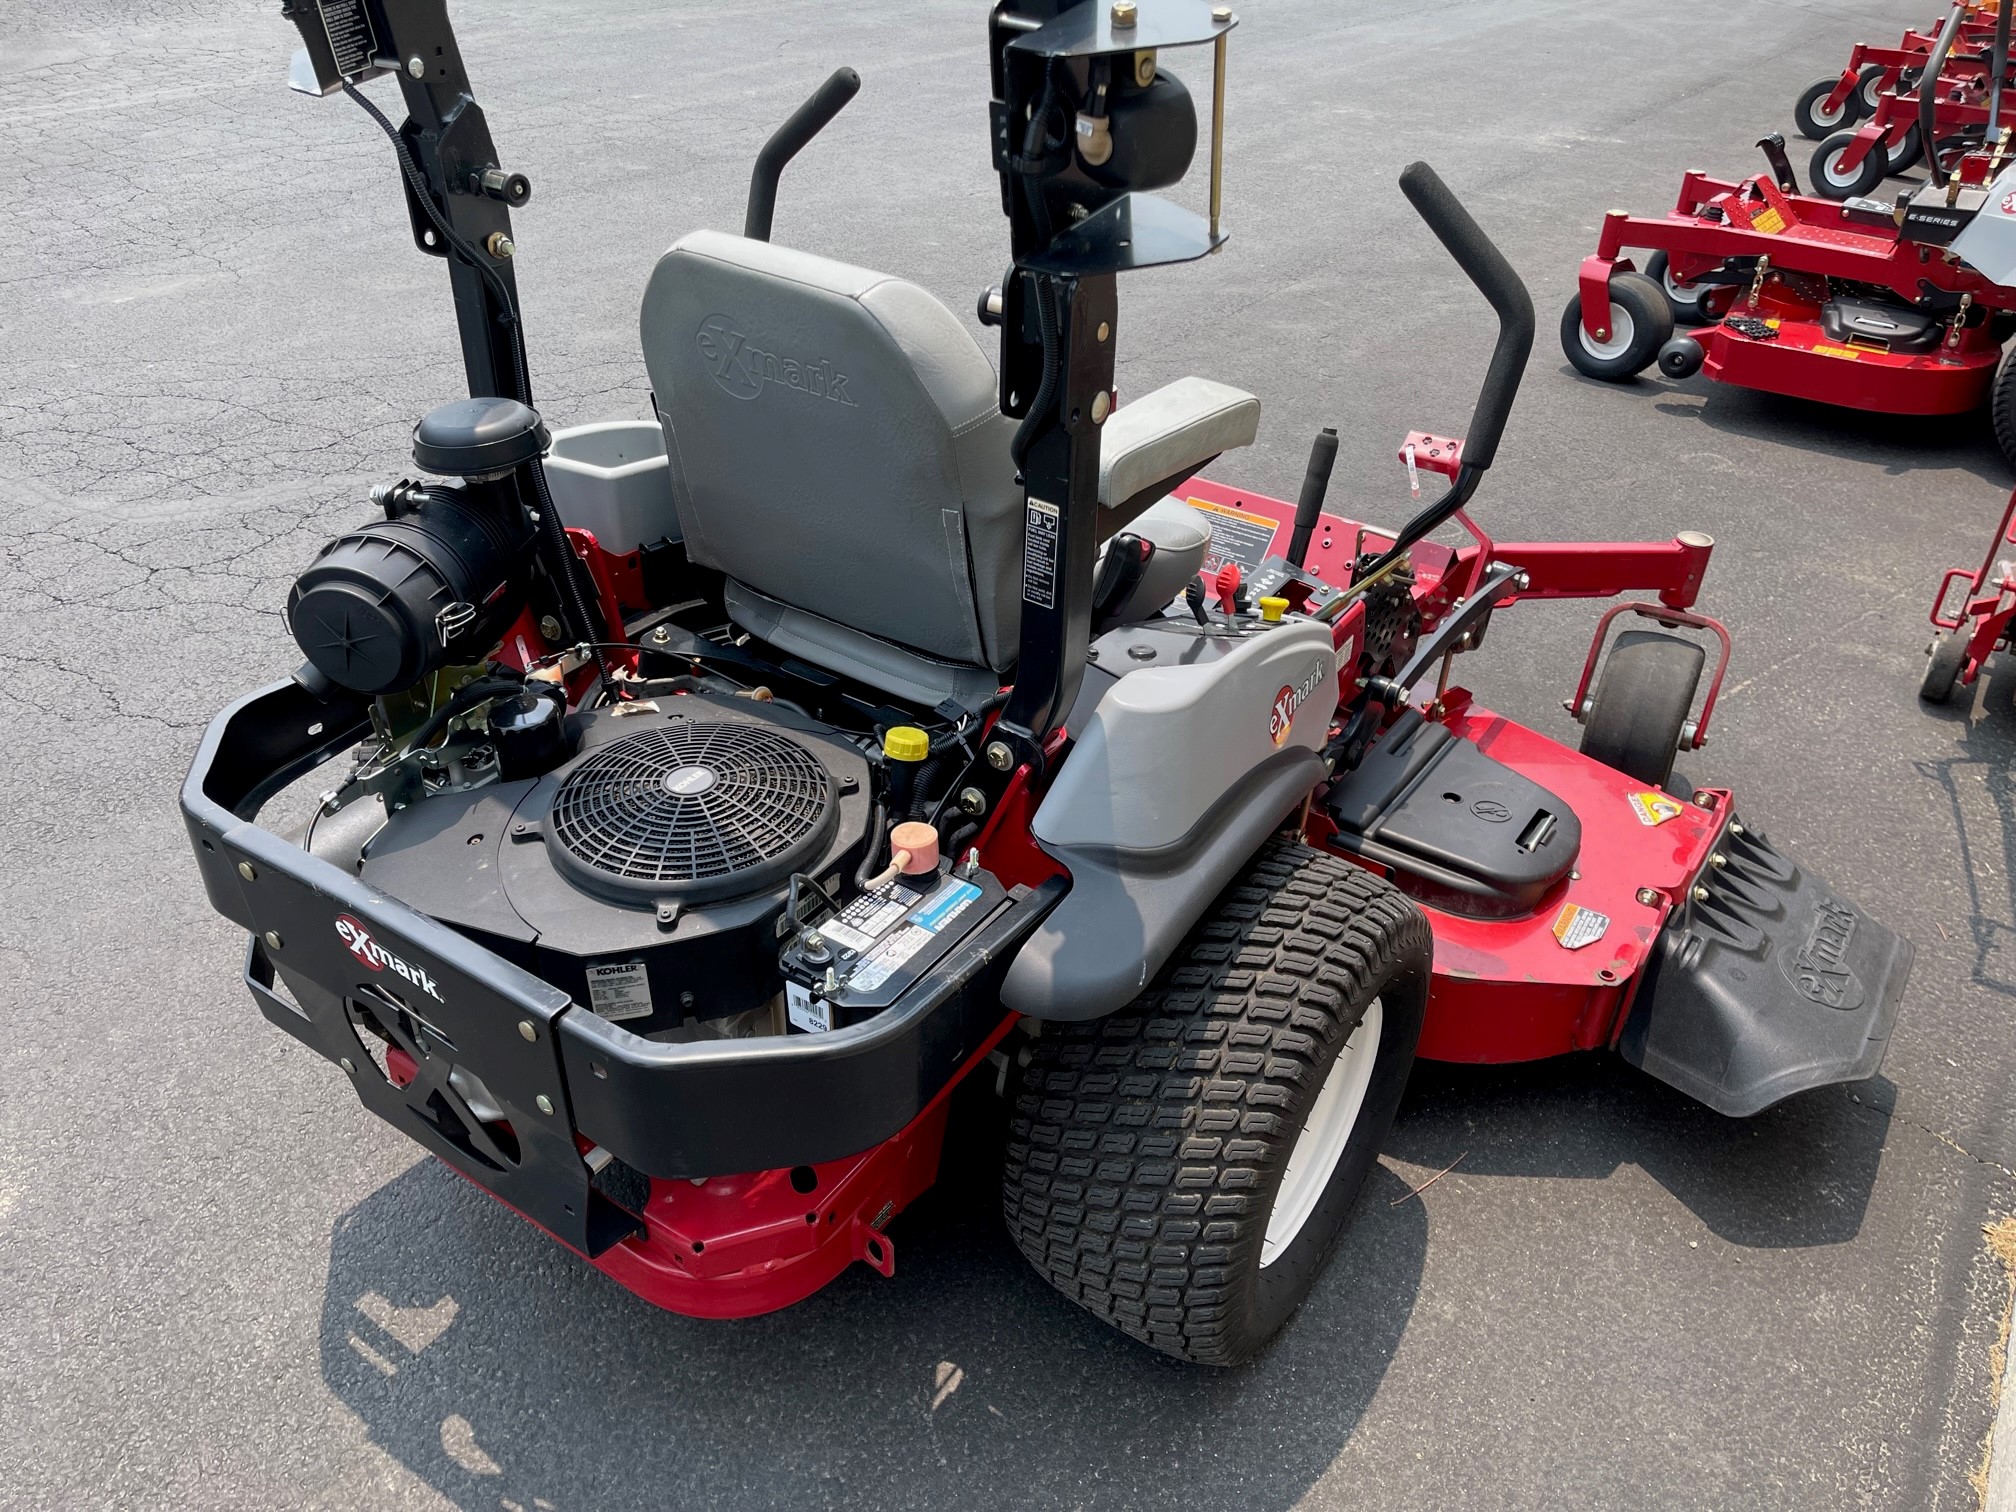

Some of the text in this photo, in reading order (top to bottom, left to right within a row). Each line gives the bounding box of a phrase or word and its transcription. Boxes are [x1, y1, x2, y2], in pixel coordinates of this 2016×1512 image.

[696, 325, 854, 406] eXmark
[1033, 501, 1058, 514] CAUTION
[1269, 660, 1324, 741] eXmark
[335, 919, 441, 1001] eXmark
[596, 965, 637, 976] KOHLER
